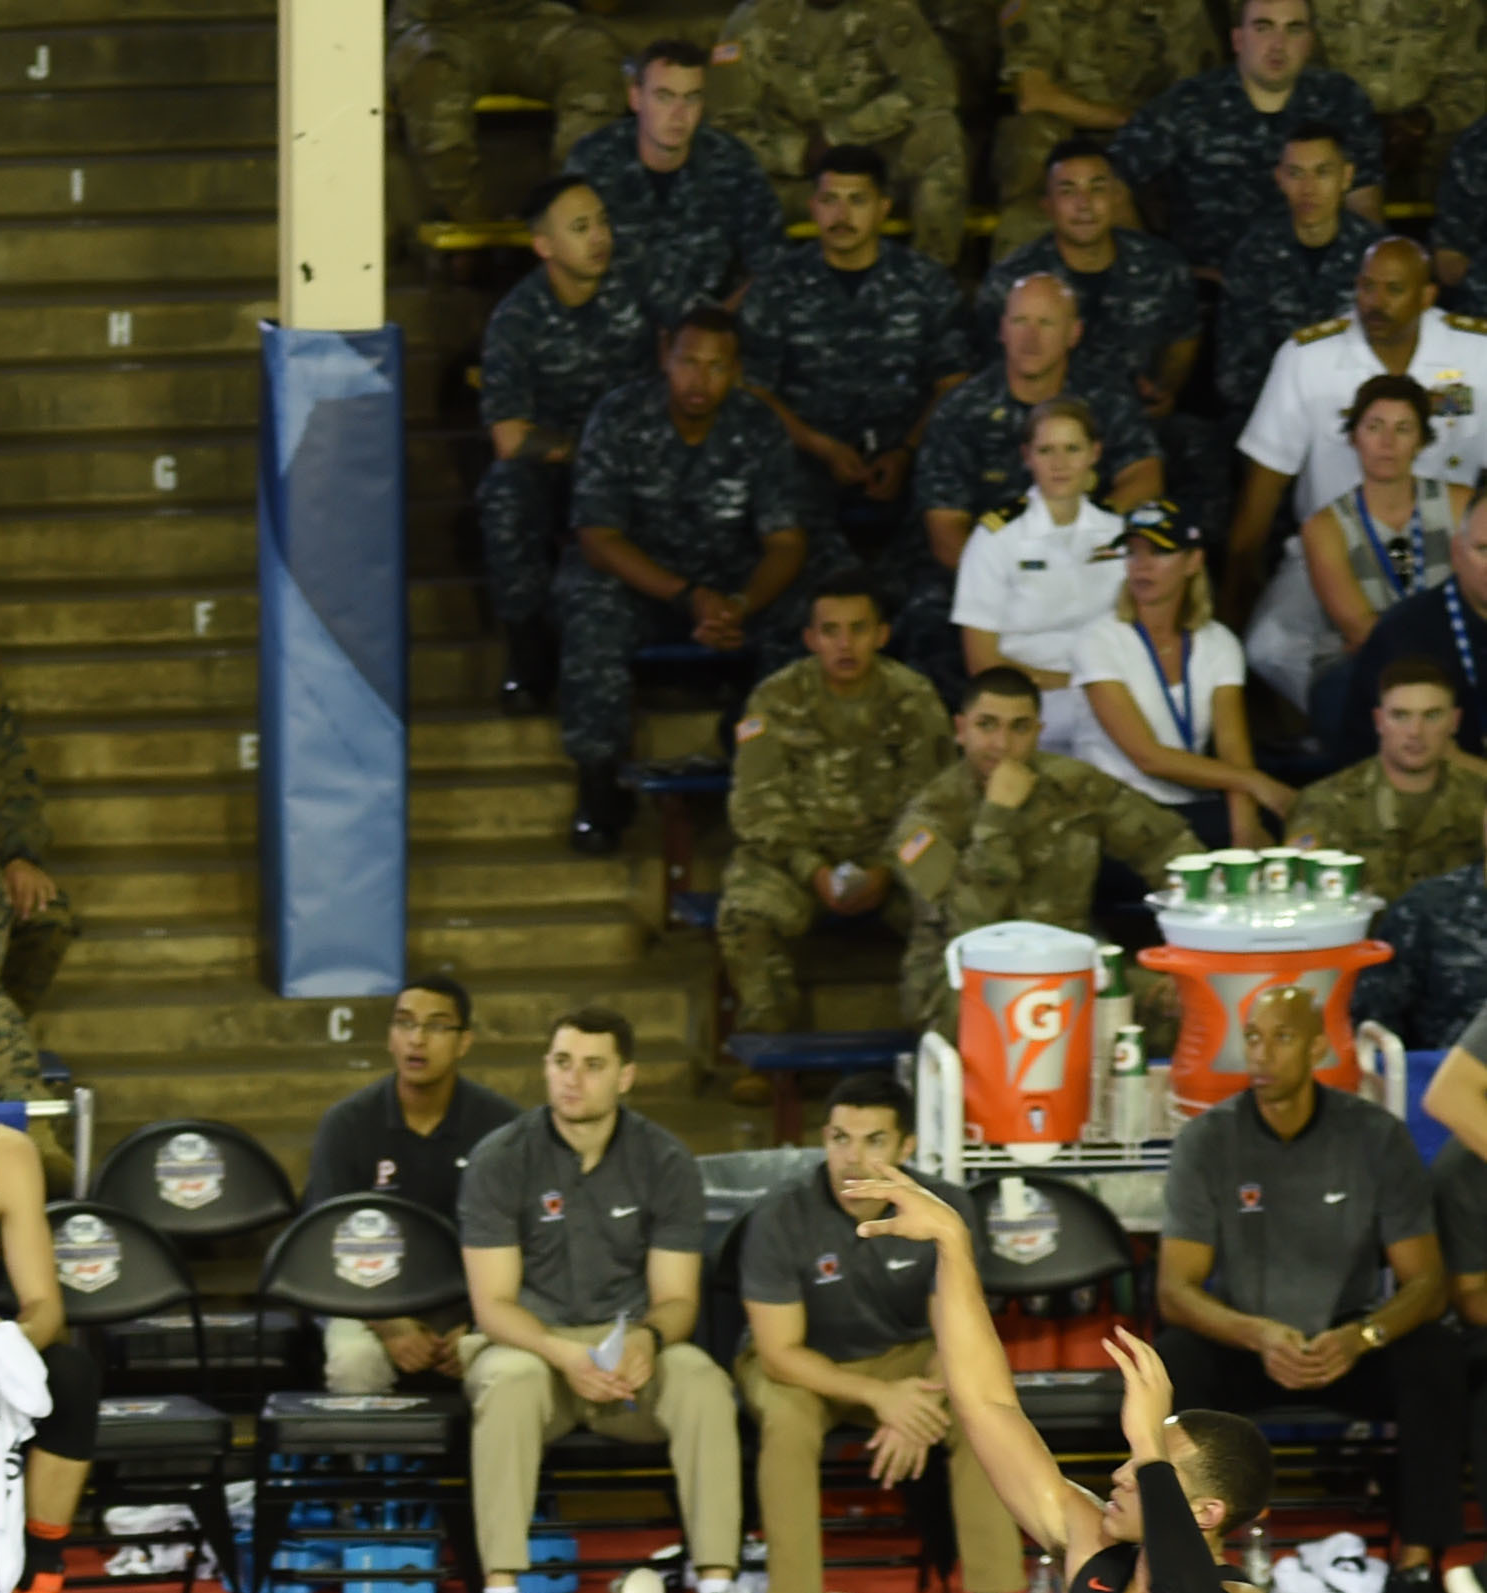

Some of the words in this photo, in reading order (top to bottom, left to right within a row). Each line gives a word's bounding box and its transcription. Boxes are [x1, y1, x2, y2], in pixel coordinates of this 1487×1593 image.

[27, 45, 49, 79] J
[72, 169, 84, 202] I
[107, 310, 133, 347] H
[152, 454, 177, 491] G
[195, 601, 215, 637] F
[238, 733, 259, 771] E
[328, 1007, 354, 1044] C
[1013, 990, 1061, 1042] G
